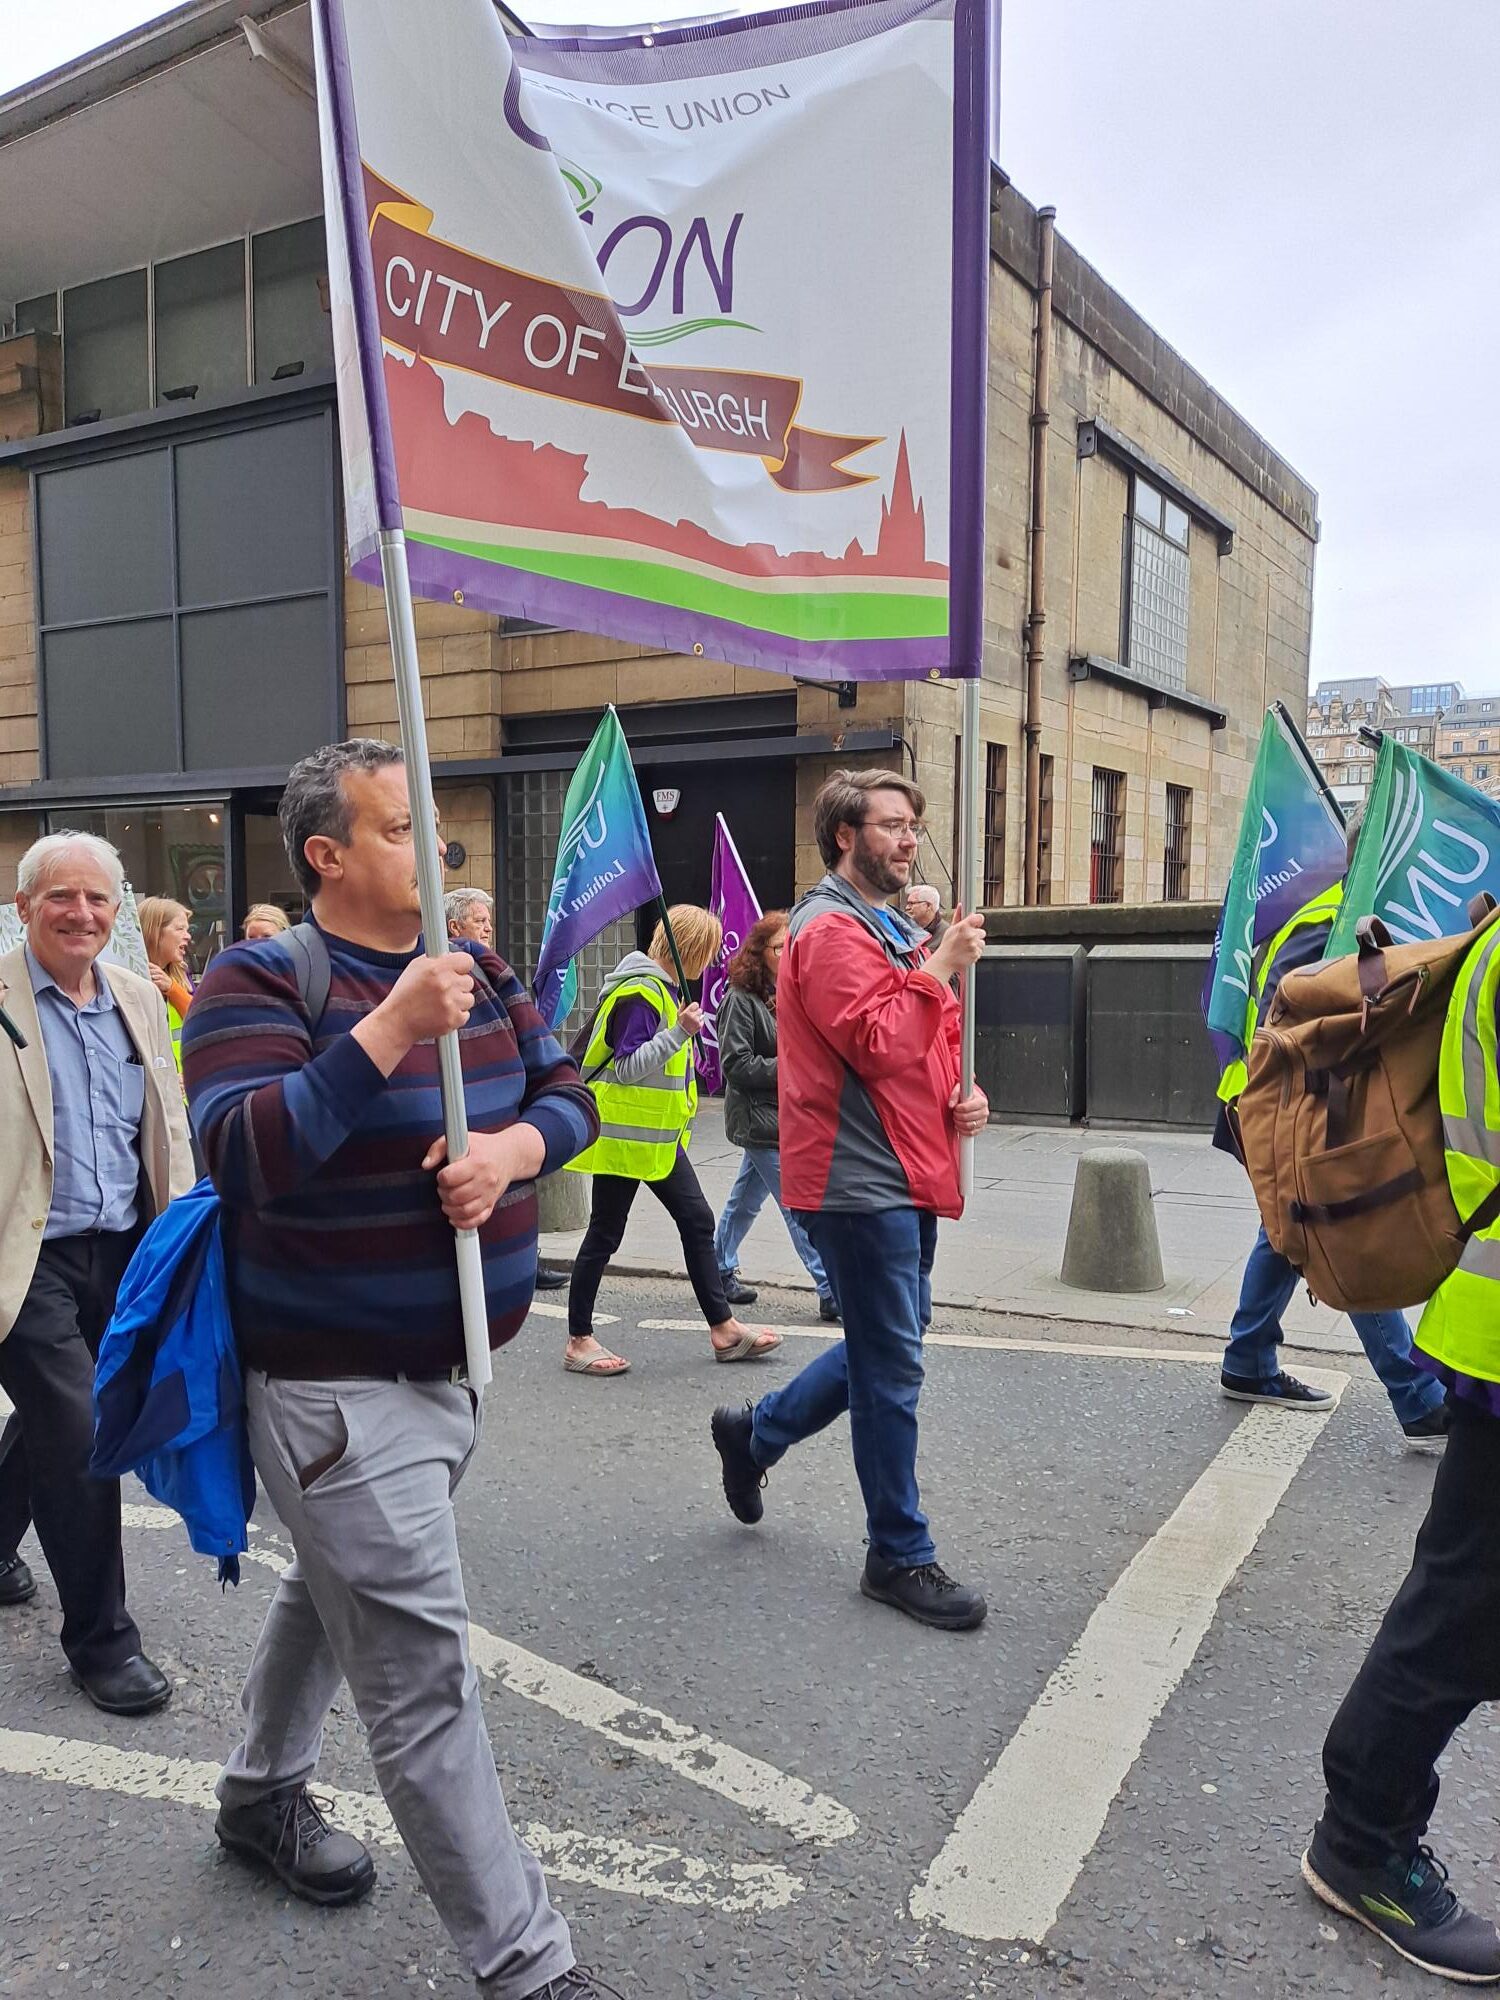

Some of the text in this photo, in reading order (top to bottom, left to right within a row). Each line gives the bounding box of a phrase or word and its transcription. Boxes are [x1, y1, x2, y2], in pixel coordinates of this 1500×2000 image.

[666, 83, 791, 130] UNION
[579, 210, 744, 316] ON
[385, 256, 771, 440] CITY OF EURGH
